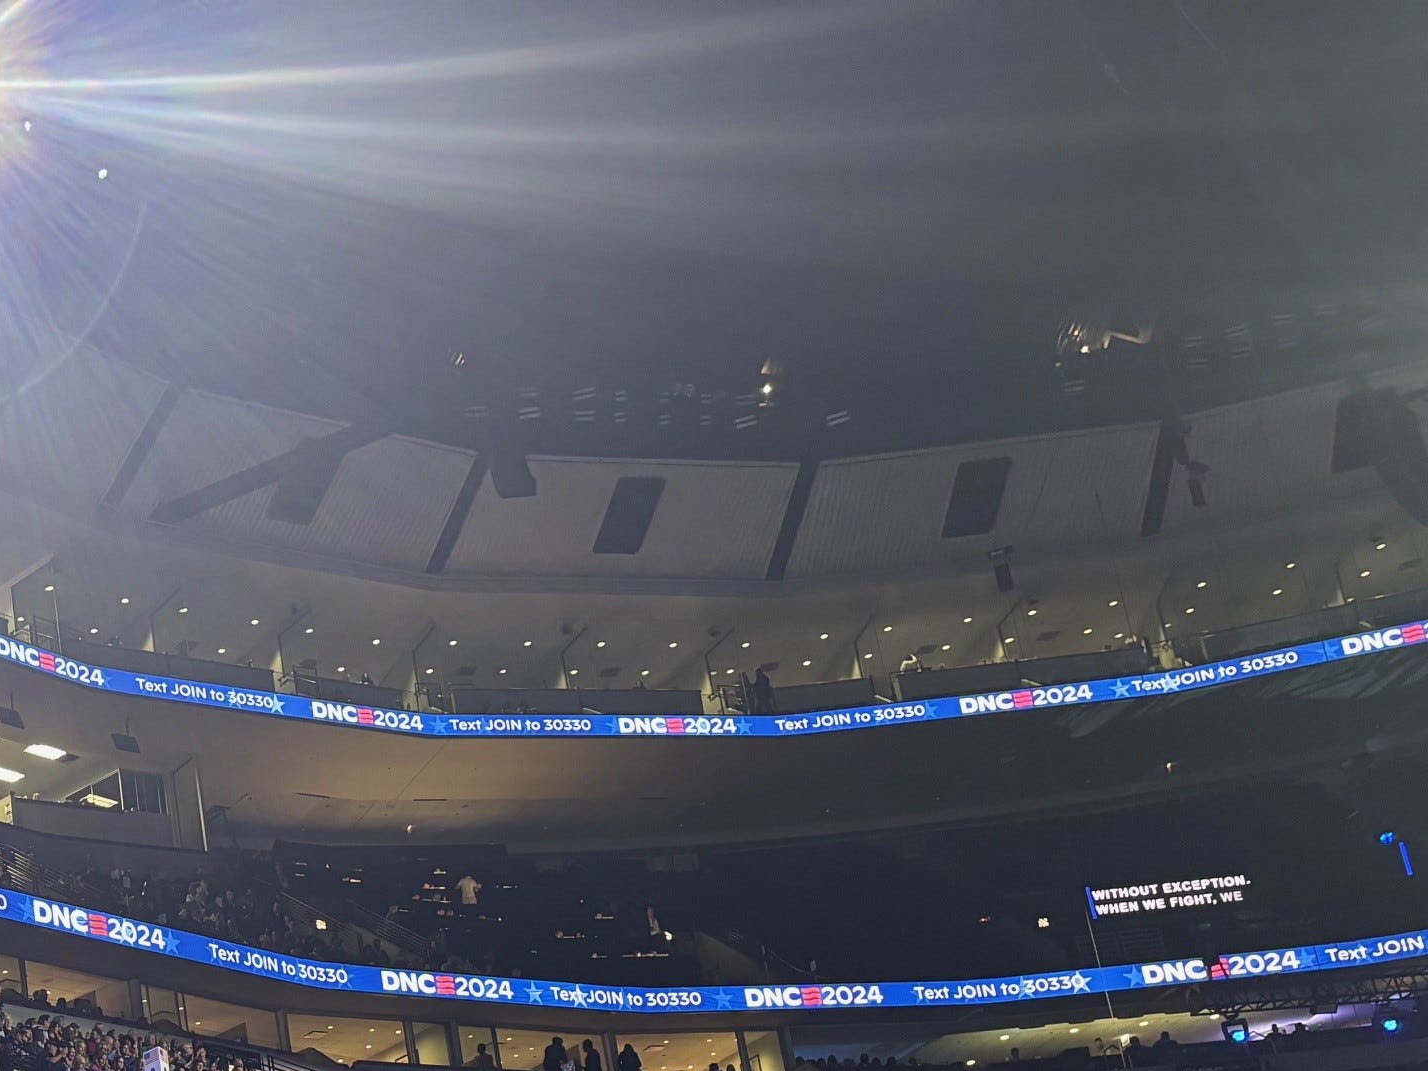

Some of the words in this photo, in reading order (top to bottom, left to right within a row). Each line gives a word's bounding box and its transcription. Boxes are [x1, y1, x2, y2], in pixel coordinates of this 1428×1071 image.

[1341, 627, 1403, 656] DNC
[55, 658, 104, 686] 2024
[1131, 678, 1165, 693] Text
[1171, 668, 1214, 686] JOIN
[1218, 665, 1236, 678] to
[1240, 651, 1298, 673] 30330
[135, 678, 167, 693] Text
[171, 683, 207, 701] JOIN
[210, 688, 224, 702] to
[228, 692, 272, 709] 30330
[960, 691, 1014, 715] DNC
[1031, 684, 1093, 706] 2024
[312, 701, 358, 723] DNC
[373, 711, 423, 731] 2024
[450, 719, 481, 732] Text
[485, 719, 522, 731] JOIN
[525, 719, 541, 731] to
[544, 719, 591, 731] 30330
[618, 716, 667, 734] DNC
[684, 716, 737, 735] 2024
[775, 718, 808, 731] Text
[813, 714, 851, 728] JOIN
[855, 711, 871, 723] to
[874, 704, 925, 721] 30330
[1092, 883, 1157, 901] WITHOUT
[1162, 874, 1251, 894] EXCEPTION.
[1095, 900, 1138, 916] WHEN
[1143, 898, 1166, 912] WE
[1170, 893, 1217, 910] FIGHT,
[1219, 890, 1243, 904] WE
[33, 898, 88, 933] DNC
[108, 917, 165, 950] 2024
[209, 943, 240, 964] Text
[245, 952, 279, 974] JOIN
[281, 959, 295, 975] to
[299, 963, 348, 984] 30330
[1325, 944, 1367, 963] Text
[1372, 936, 1425, 958] JOIN
[1141, 958, 1207, 985] DNC
[1228, 951, 1300, 976] 2024
[381, 970, 435, 994] DNC
[455, 977, 514, 1000] 2024
[550, 986, 584, 1002] Text
[585, 990, 623, 1005] JOIN
[627, 992, 643, 1006] to
[647, 991, 701, 1006] 30330
[745, 987, 801, 1008] DNC
[821, 985, 884, 1006] 2024
[914, 983, 950, 1000] Text
[954, 980, 996, 999] JOIN
[1000, 979, 1020, 996] to
[1023, 975, 1085, 995] 30330
